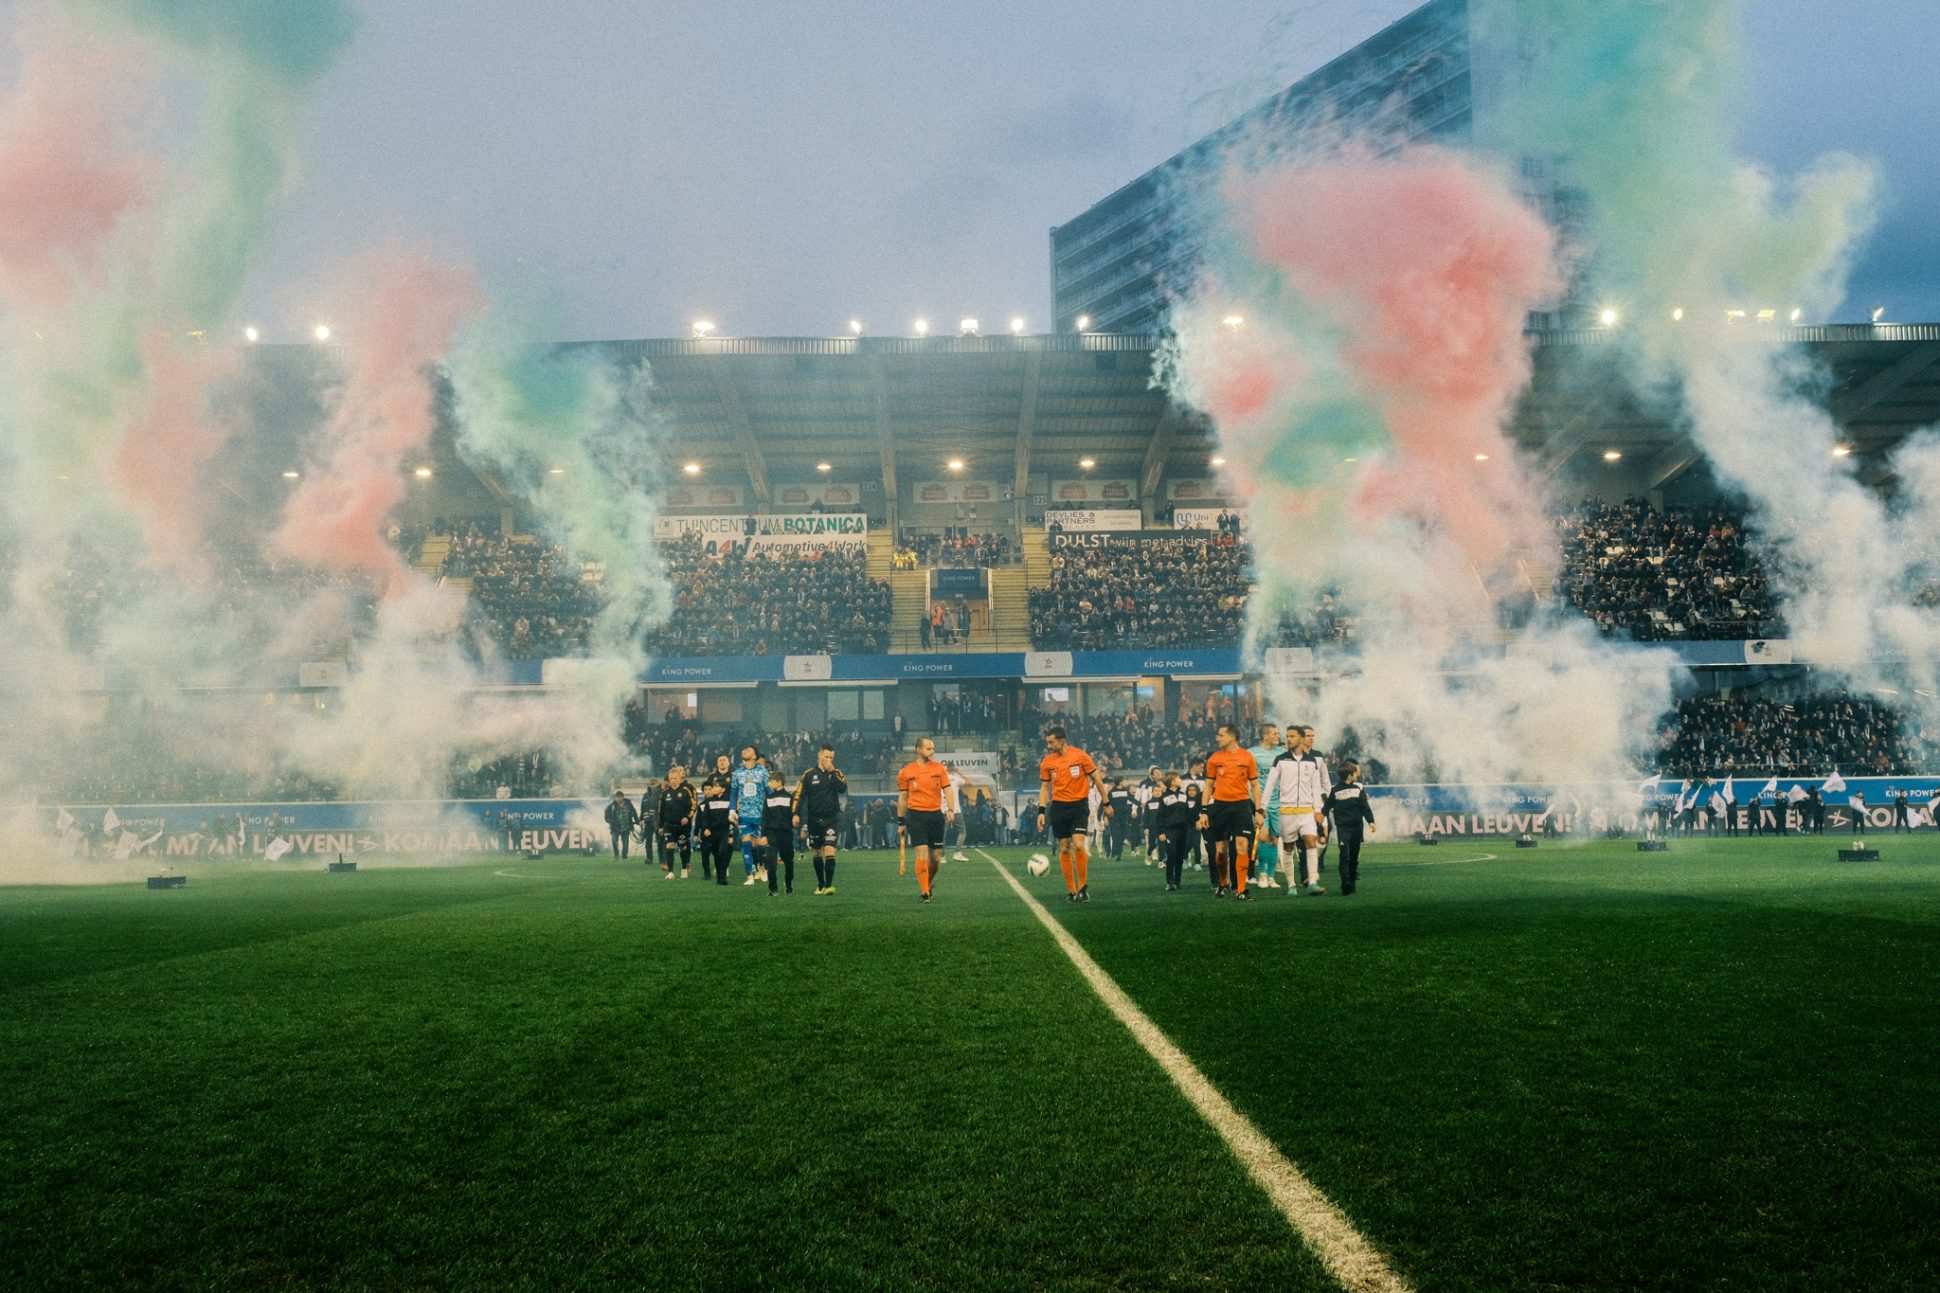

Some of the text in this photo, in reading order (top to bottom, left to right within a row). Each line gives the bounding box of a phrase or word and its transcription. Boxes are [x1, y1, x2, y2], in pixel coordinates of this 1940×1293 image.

[676, 516, 866, 534] TUINCENTUM BOTANICA
[1046, 517, 1096, 525] PARTNERS
[705, 538, 753, 557] A4W
[903, 663, 953, 672] KING POWER
[1143, 660, 1194, 668] KING POWER
[661, 666, 713, 676] KING POWER
[956, 759, 988, 767] LEUVEN
[1527, 795, 1553, 804] POWE
[1655, 793, 1682, 801] POWE
[523, 812, 555, 820] POWER
[252, 832, 354, 855] LUVEN!
